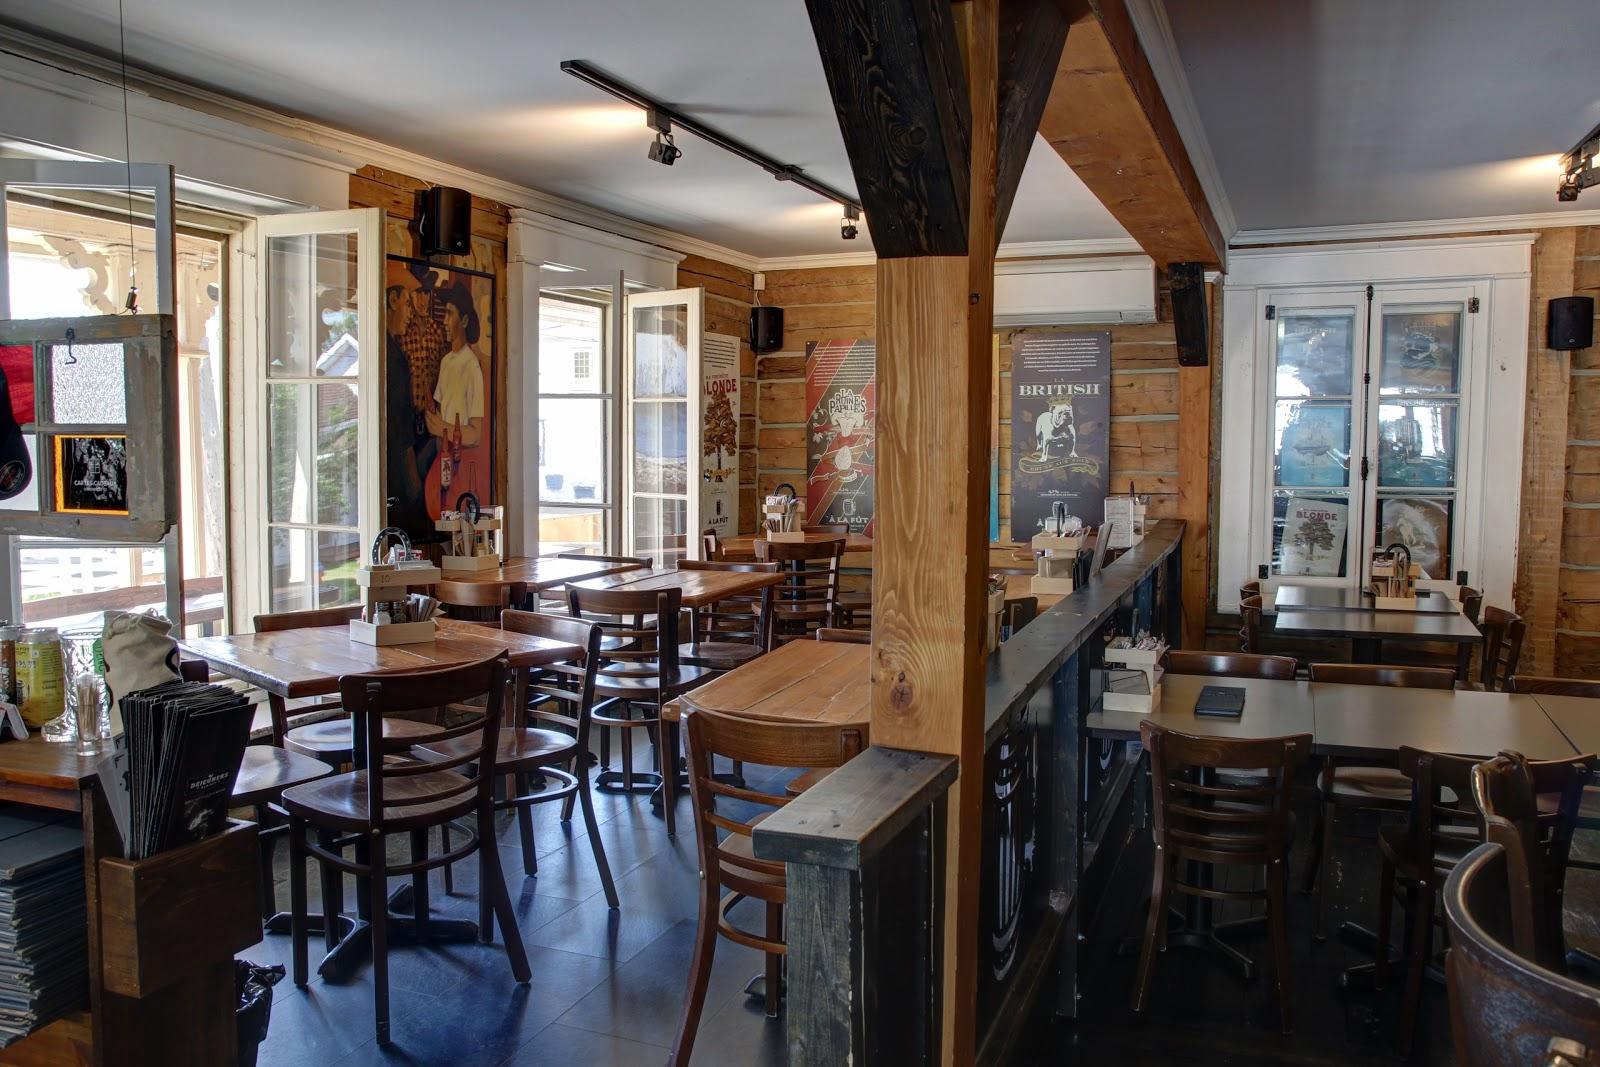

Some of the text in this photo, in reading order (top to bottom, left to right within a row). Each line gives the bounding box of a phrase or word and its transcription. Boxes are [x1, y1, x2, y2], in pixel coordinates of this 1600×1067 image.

[1019, 384, 1100, 396] BRITISH
[850, 515, 869, 524] FÛT
[1296, 511, 1338, 521] BLONDE
